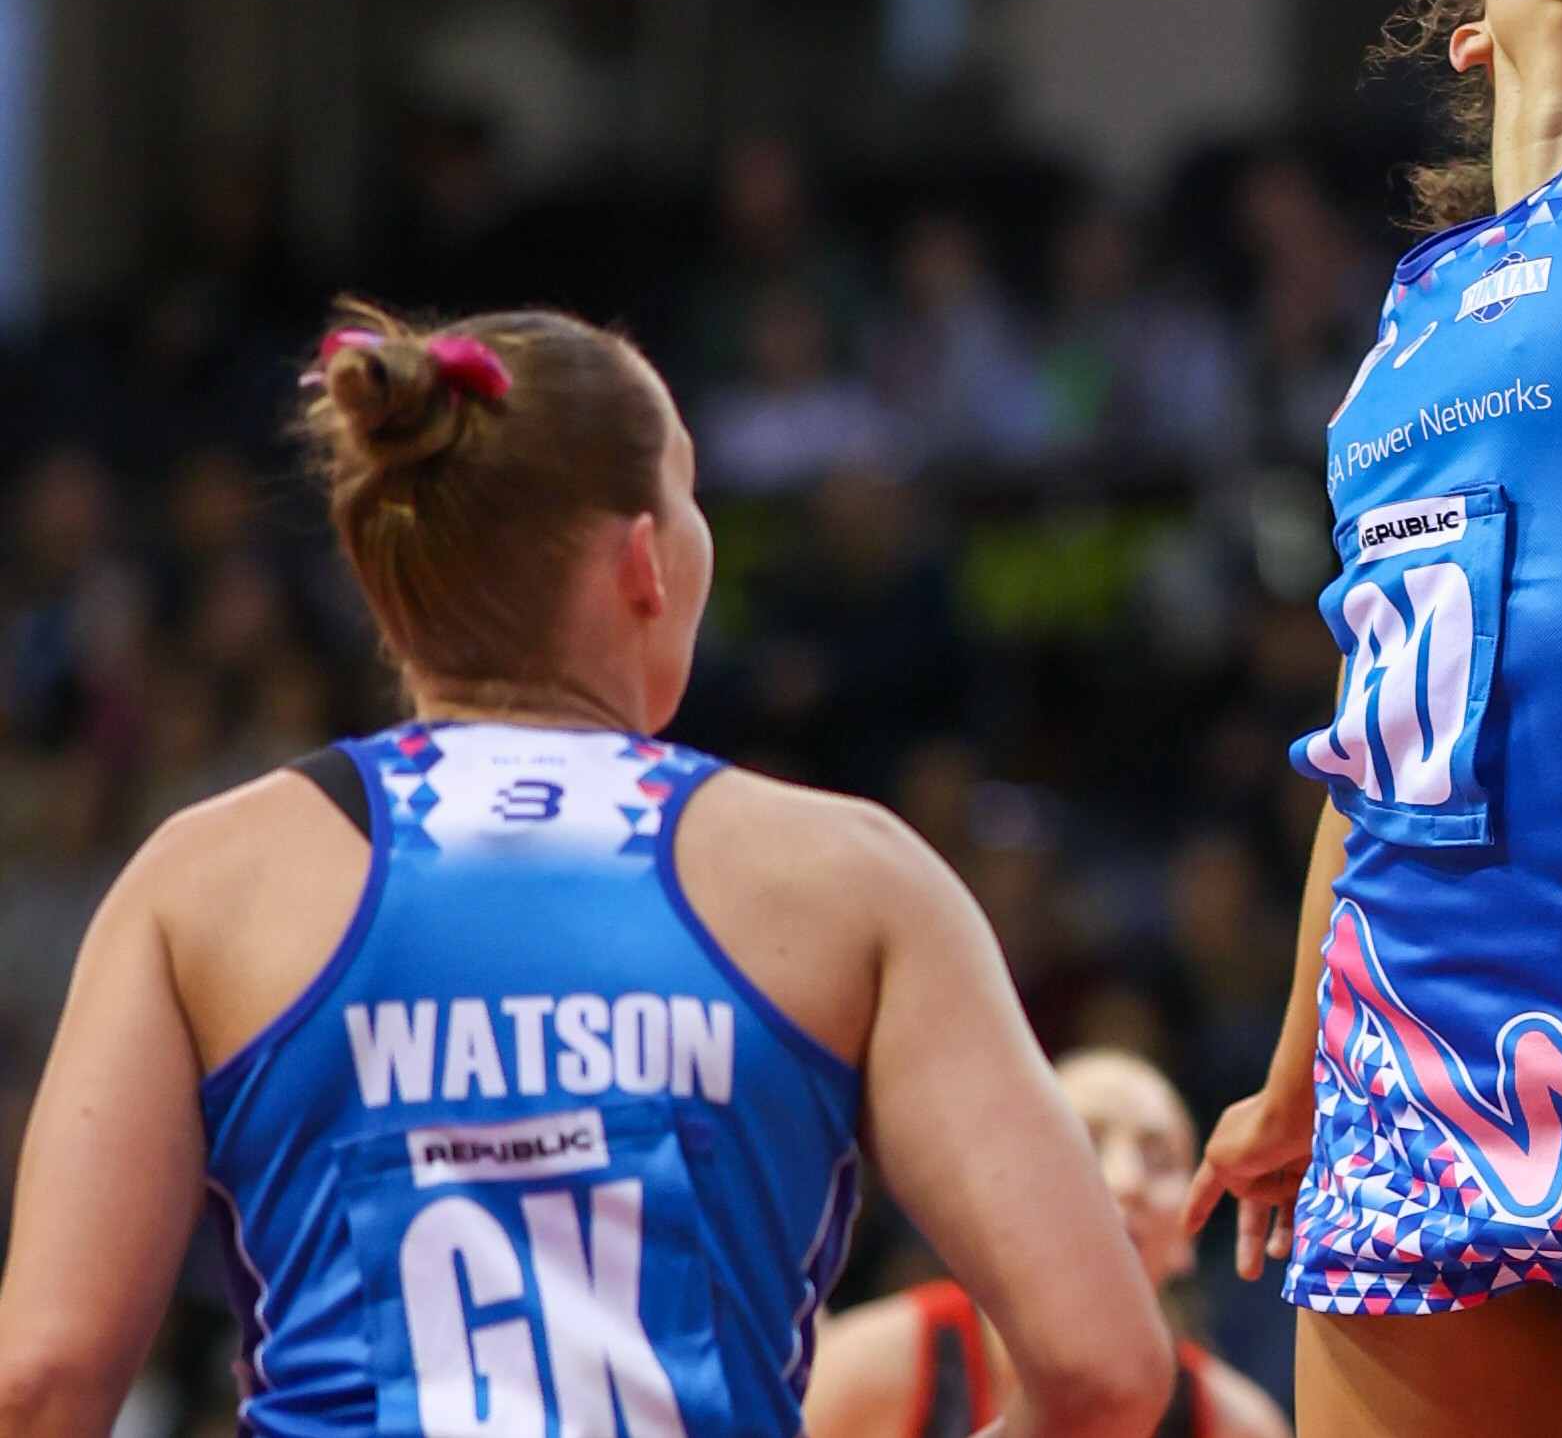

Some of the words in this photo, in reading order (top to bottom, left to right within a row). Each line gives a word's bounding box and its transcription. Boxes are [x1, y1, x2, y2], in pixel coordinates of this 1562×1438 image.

[1348, 420, 1415, 478] Power
[1419, 377, 1553, 441] Networks
[343, 991, 736, 1109] WATSON
[424, 1126, 594, 1165] REPUBLIC
[400, 1177, 692, 1438] GK
